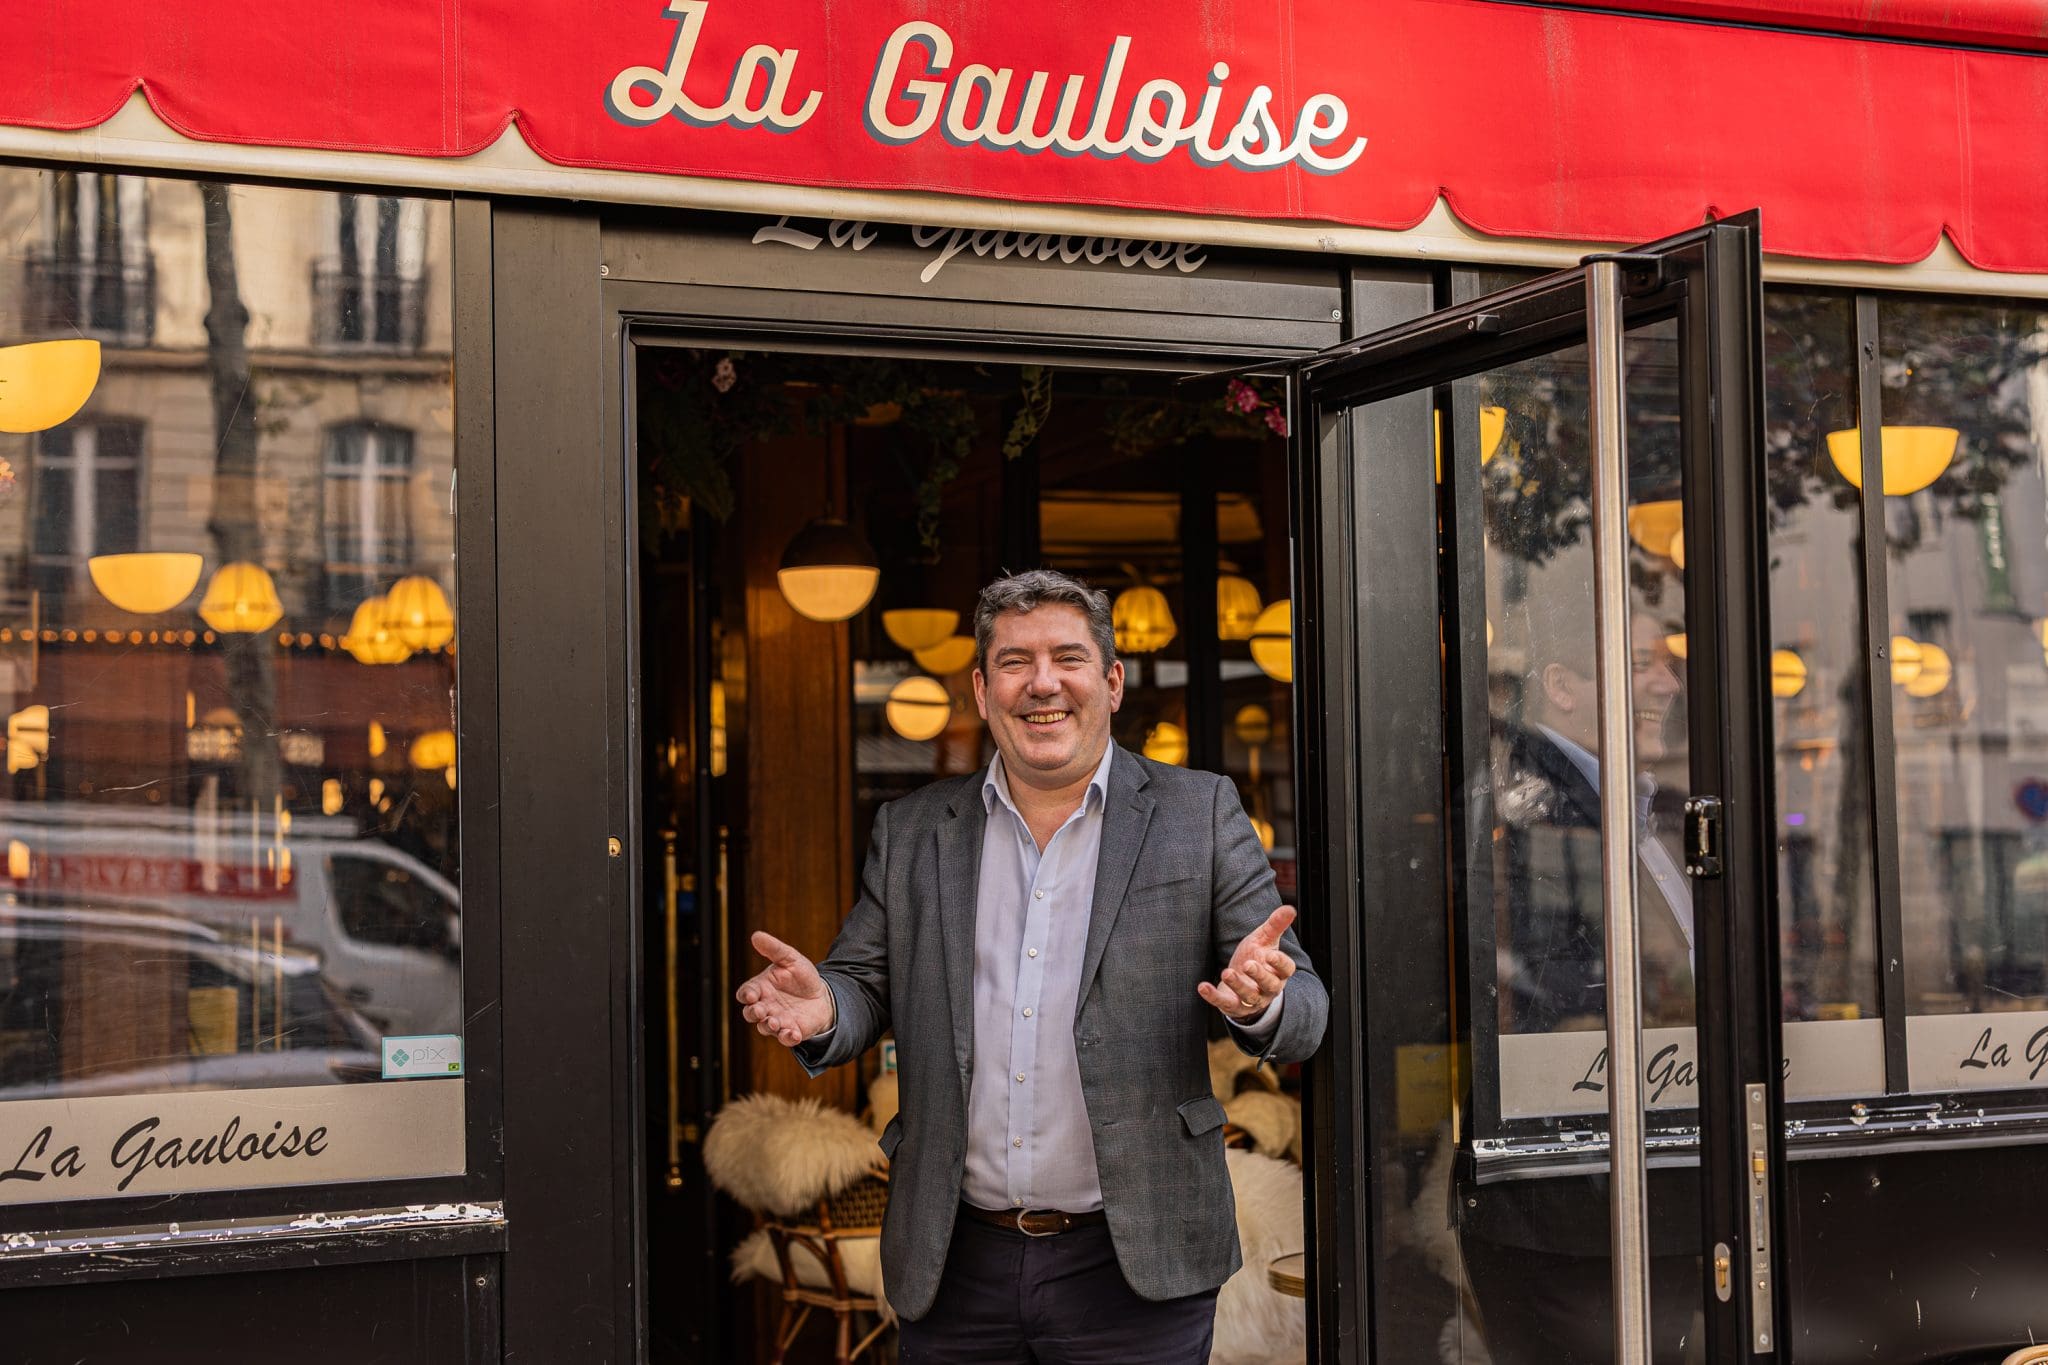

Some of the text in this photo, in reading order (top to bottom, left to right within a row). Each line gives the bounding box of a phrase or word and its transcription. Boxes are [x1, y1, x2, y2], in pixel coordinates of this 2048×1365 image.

[604, 0, 1369, 176] La Gauloise
[412, 1046, 447, 1065] pix
[1572, 1047, 1609, 1092] L
[1960, 1027, 2012, 1069] La
[0, 1115, 329, 1192] La Gauloise
